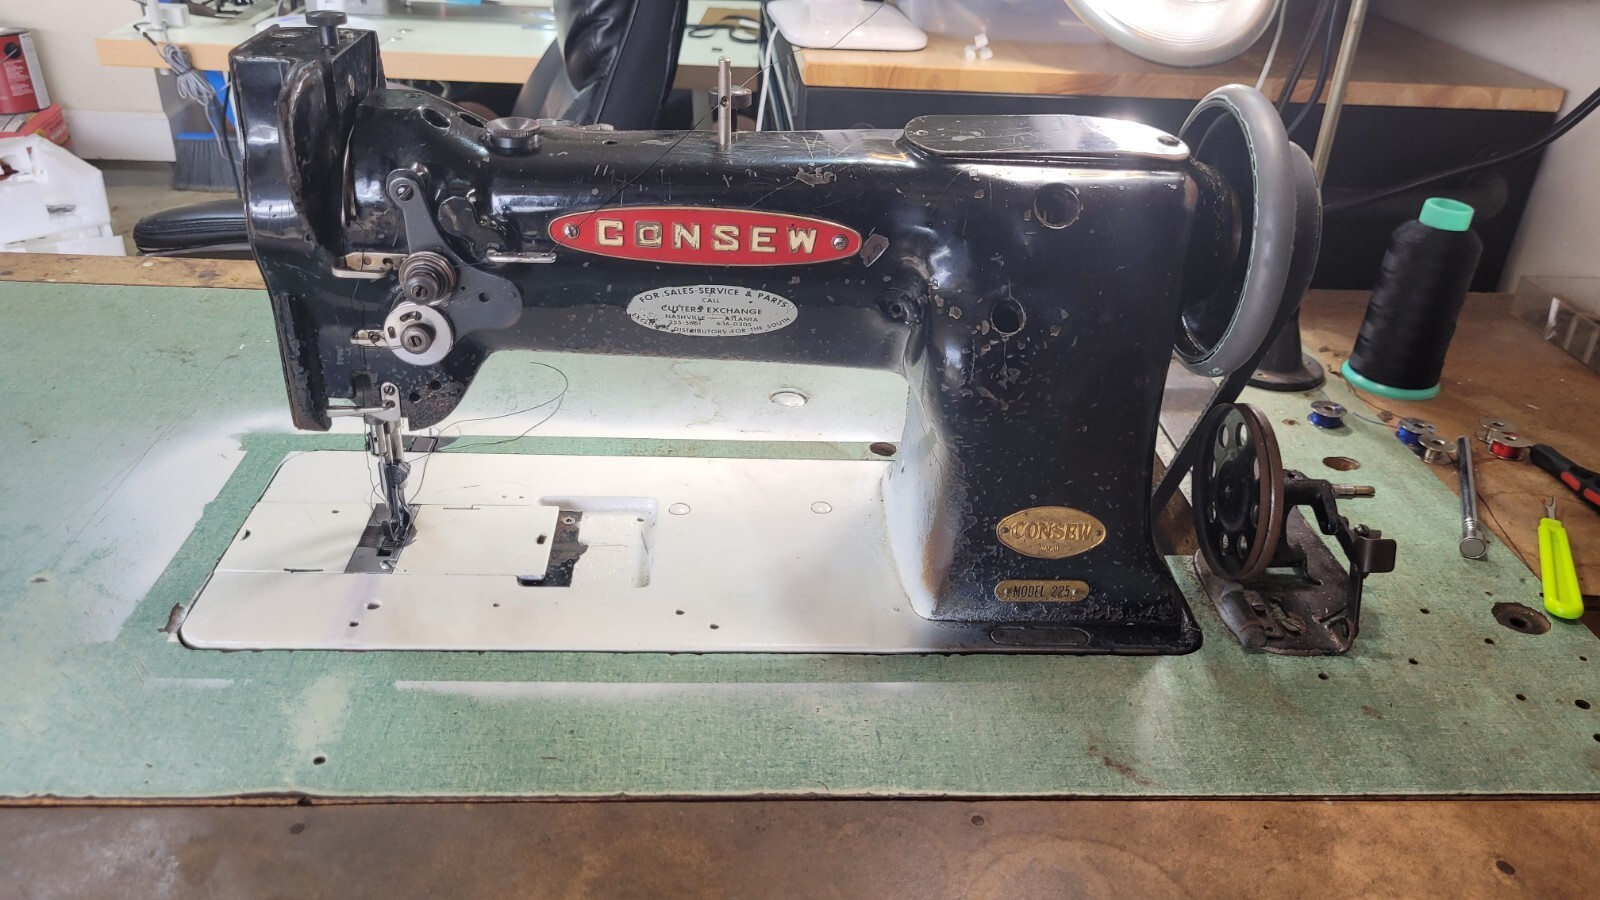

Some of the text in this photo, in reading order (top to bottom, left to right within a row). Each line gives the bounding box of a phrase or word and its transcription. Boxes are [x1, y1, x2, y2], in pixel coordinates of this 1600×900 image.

[596, 218, 819, 255] CONSEW
[639, 292, 660, 303] FOR
[757, 292, 788, 308] PARTS
[706, 307, 763, 315] EXCHANGE
[767, 317, 791, 329] SOUTH
[1010, 521, 1092, 541] CONSEW
[1012, 585, 1071, 598] MODEL 225
